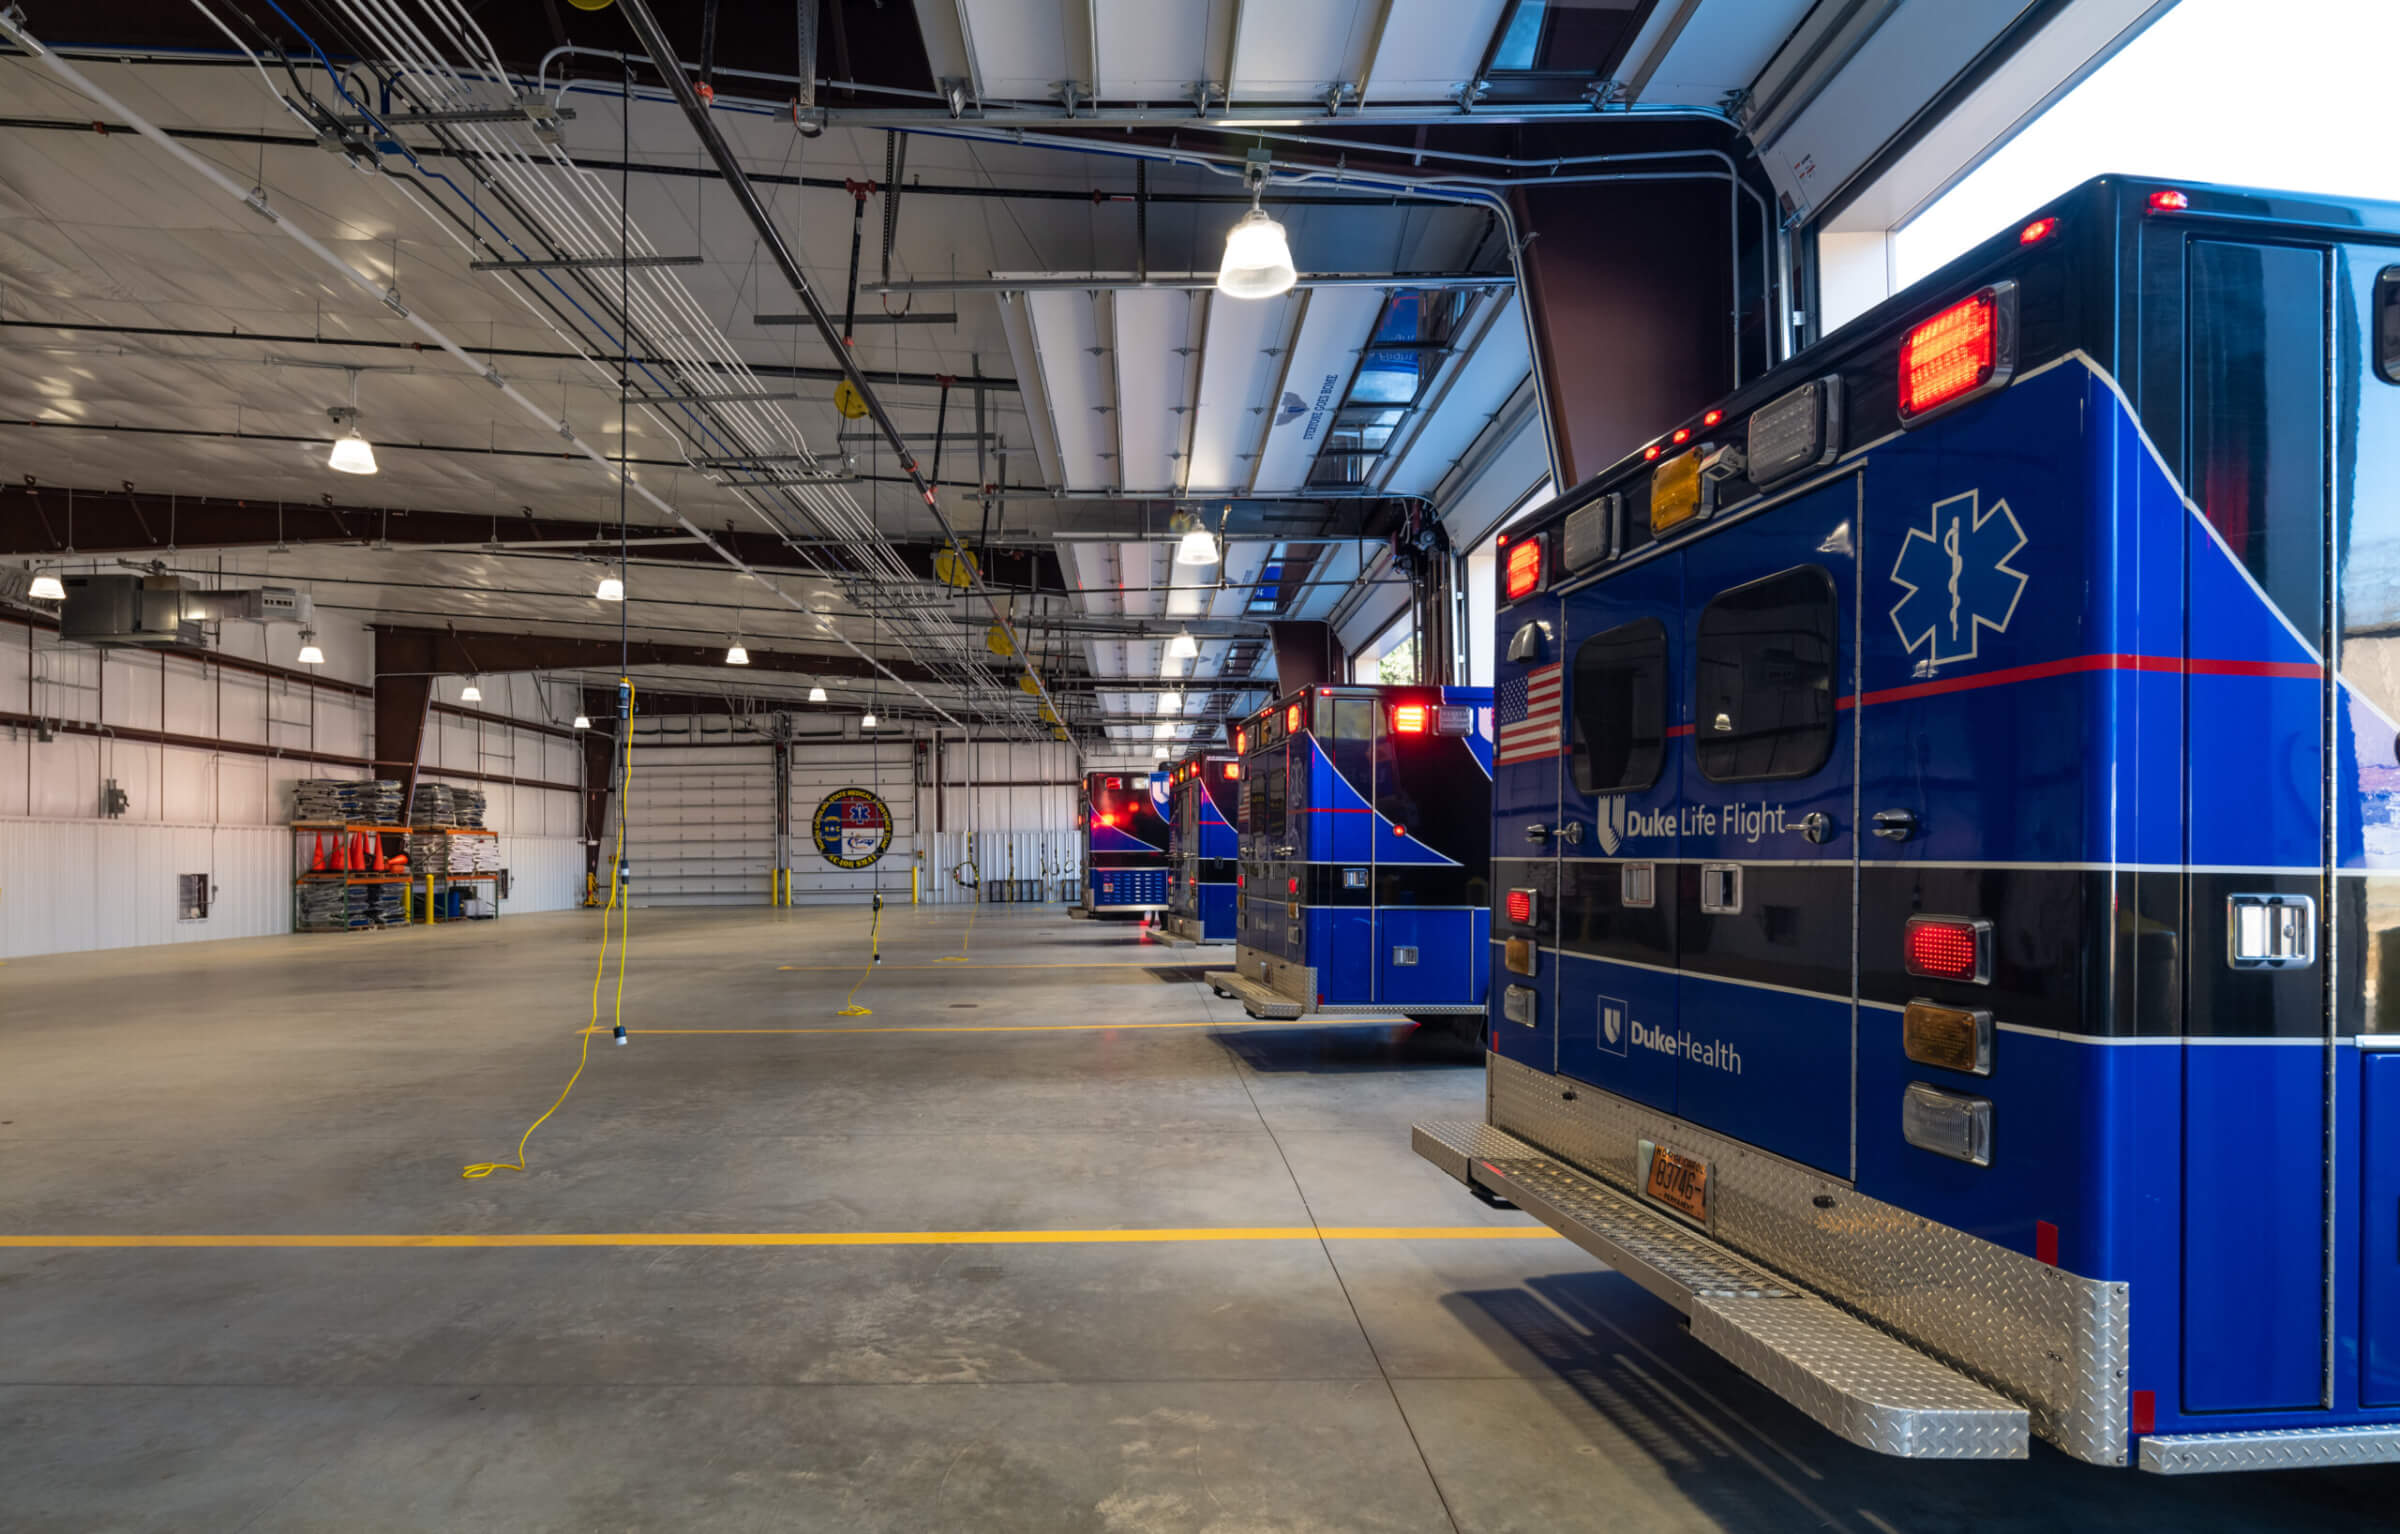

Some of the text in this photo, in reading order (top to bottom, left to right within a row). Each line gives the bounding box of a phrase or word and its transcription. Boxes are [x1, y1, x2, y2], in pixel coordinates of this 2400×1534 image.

[1314, 395, 1330, 411] GOES
[1627, 801, 1786, 843] Duke Life Flight
[1631, 1021, 1742, 1075] DukeHealth
